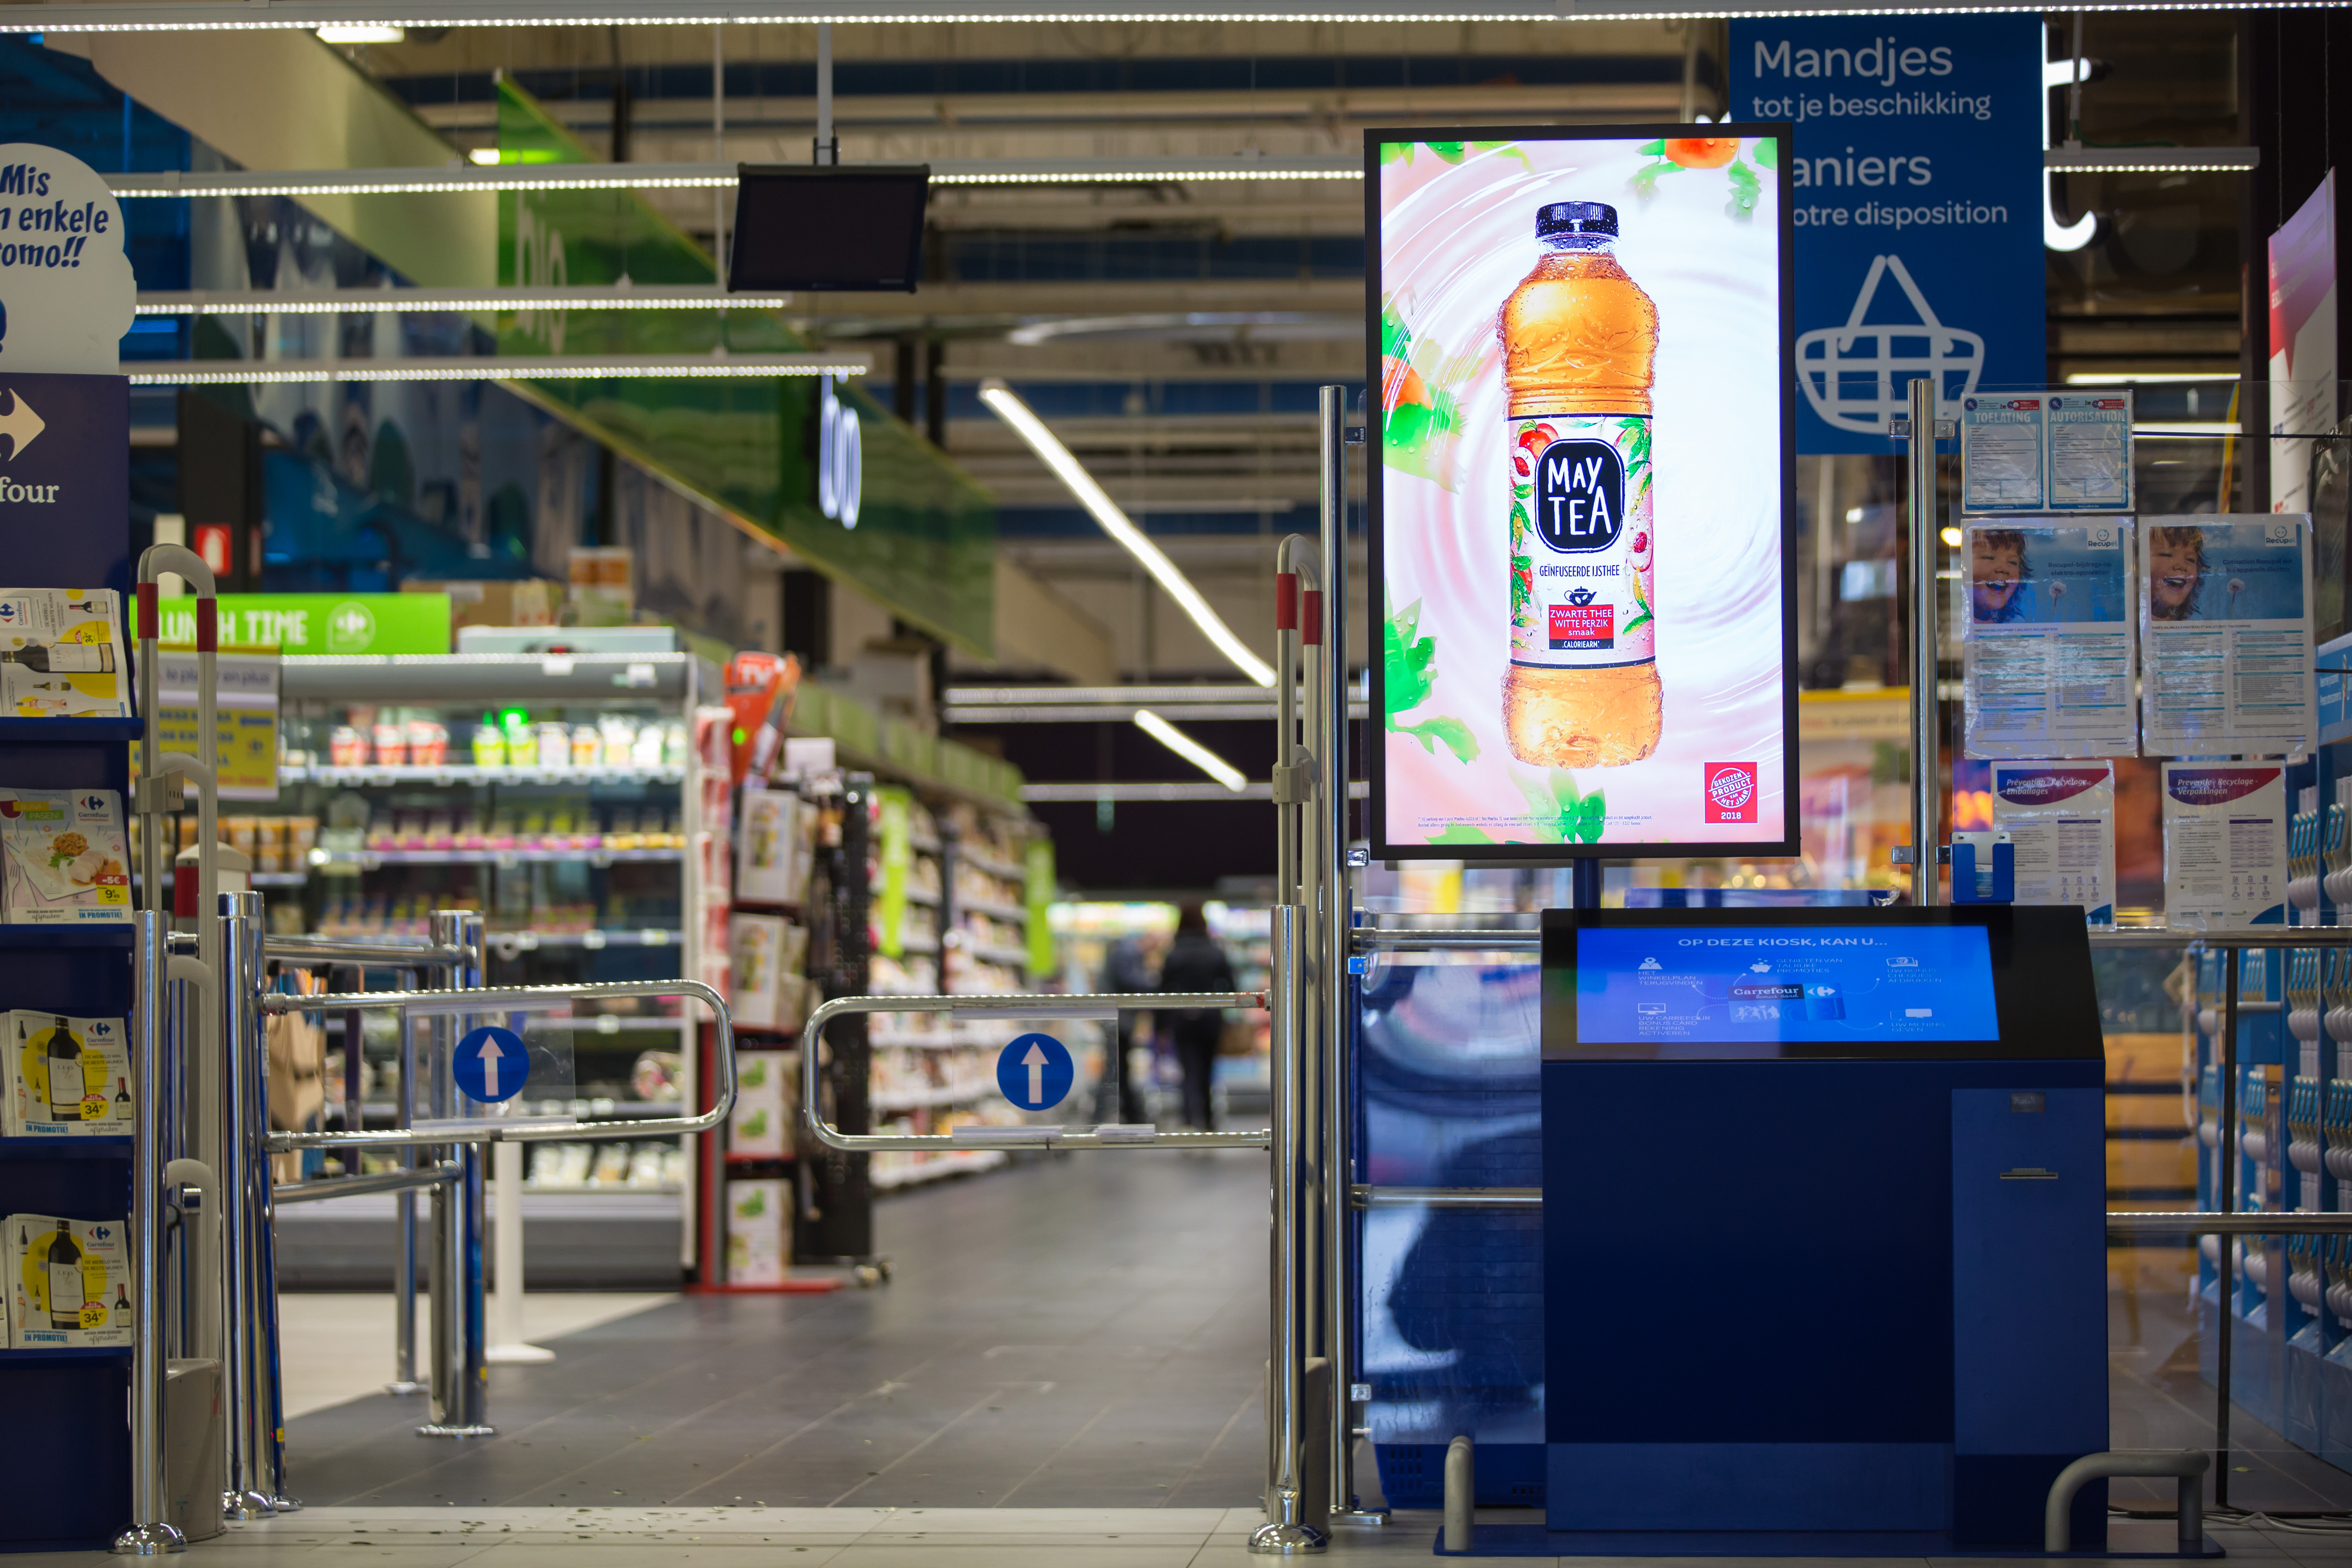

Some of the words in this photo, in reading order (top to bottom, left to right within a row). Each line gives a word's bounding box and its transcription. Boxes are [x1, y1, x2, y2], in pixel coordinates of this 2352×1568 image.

[1754, 37, 1953, 86] Mandjes
[1753, 96, 1793, 117] tot
[1796, 94, 1822, 122] je
[1830, 92, 1991, 120] beschikking
[1793, 147, 1932, 187] aniers
[0, 164, 51, 197] Mis
[19, 199, 109, 233] enkele
[1794, 203, 1849, 226] otre
[1855, 200, 2008, 230] disposition
[0, 236, 88, 268] omo!!
[1975, 413, 2030, 423] TOELATING
[2050, 412, 2125, 422] AUTORISATION
[1548, 457, 1602, 494] MAY
[1548, 486, 1612, 535] TEA
[1540, 564, 1590, 577] GEÏNFUSEERDE
[1593, 565, 1619, 576] IJSTHEE
[1593, 609, 1612, 617] THEE
[159, 610, 236, 643] LUNH
[244, 610, 309, 645] TIME
[1569, 627, 1595, 636] smaak
[1712, 778, 1751, 797] PRODUCT
[1714, 772, 1742, 787] GEKOZEN
[2007, 778, 2045, 786] Prévention
[2052, 778, 2087, 786] Recyclage
[1721, 797, 1734, 806] HET
[1735, 789, 1749, 804] JAAR
[34, 1125, 68, 1133] PROMOTIE!
